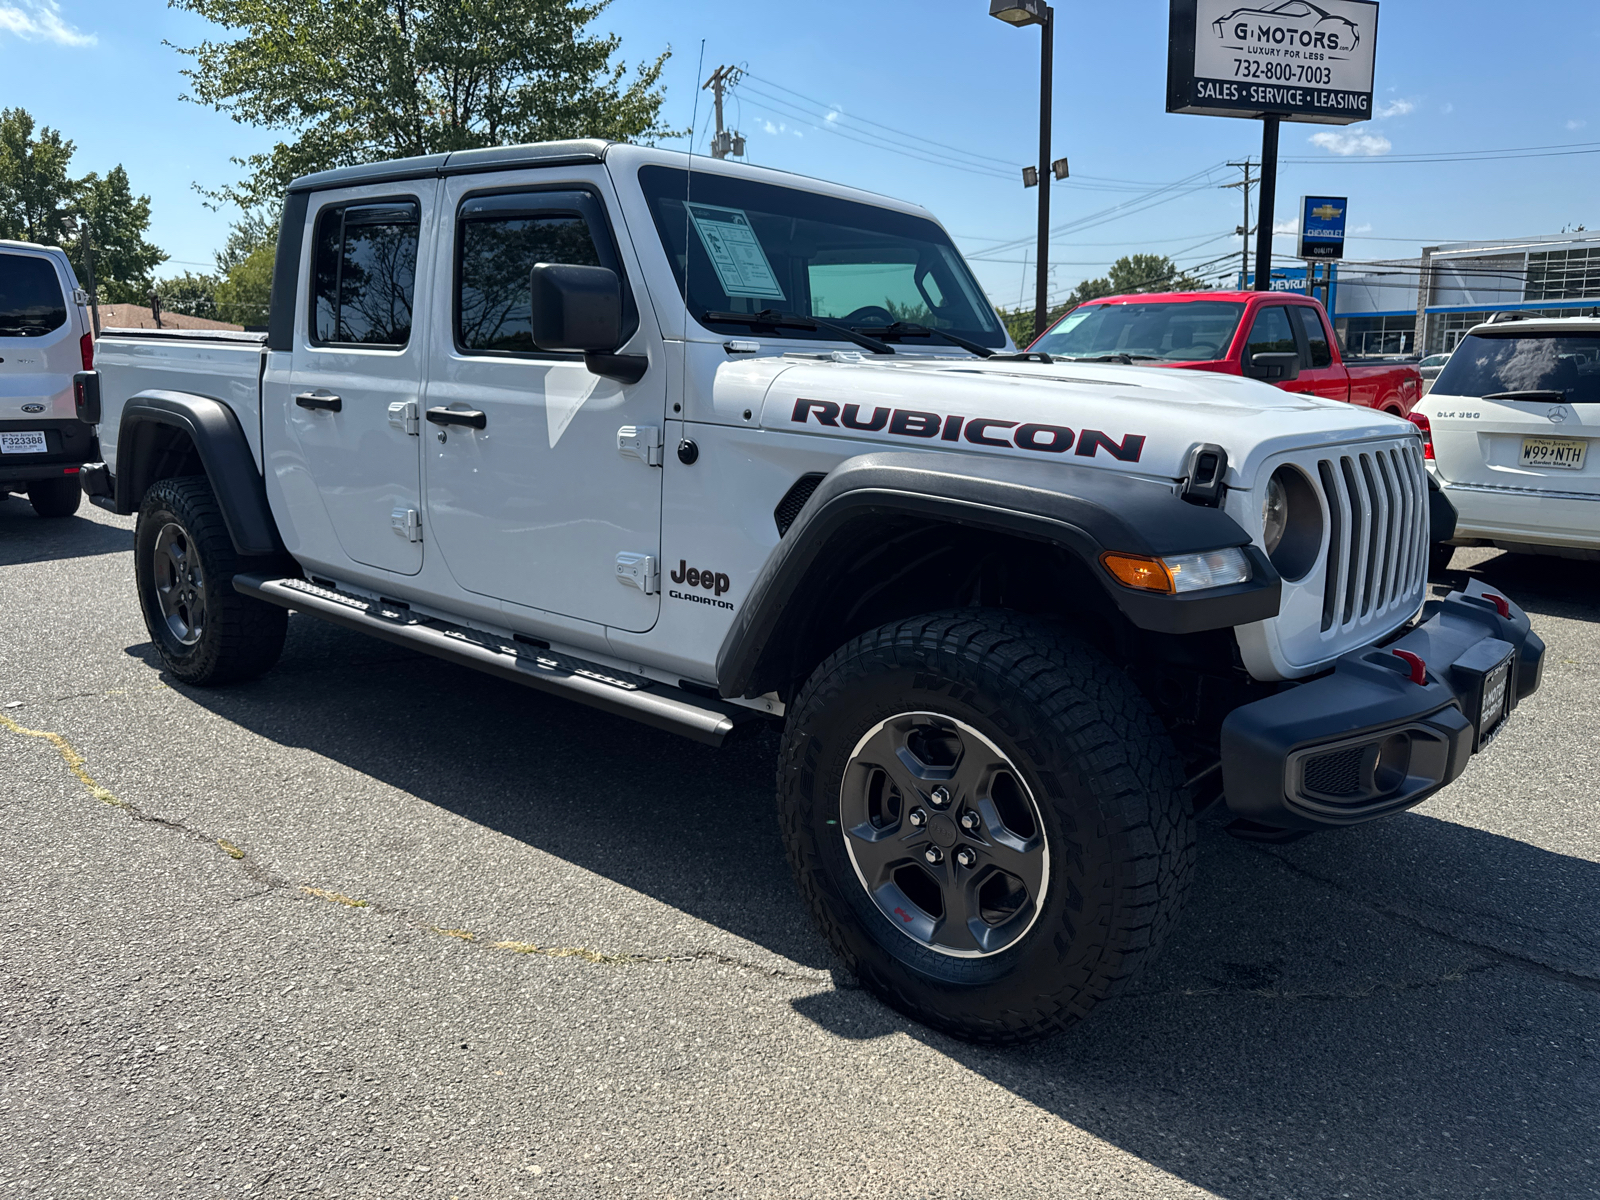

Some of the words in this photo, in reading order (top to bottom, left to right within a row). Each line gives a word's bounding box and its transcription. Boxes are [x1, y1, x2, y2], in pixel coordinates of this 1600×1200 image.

[1247, 45, 1281, 57] LUXURY
[1283, 50, 1300, 59] FOR
[1303, 52, 1325, 61] LESS
[1233, 58, 1332, 85] 732-800-7003
[1197, 81, 1239, 100] SALES
[1250, 86, 1304, 106] SERVICE
[1314, 91, 1368, 110] LEASING
[1307, 229, 1343, 238] CHEVROLET
[1313, 247, 1334, 255] QUALITY
[791, 397, 1147, 463] RUBICON
[2, 436, 43, 446] F323388
[670, 559, 730, 597] Jeep
[669, 590, 735, 611] GLADIATOR
